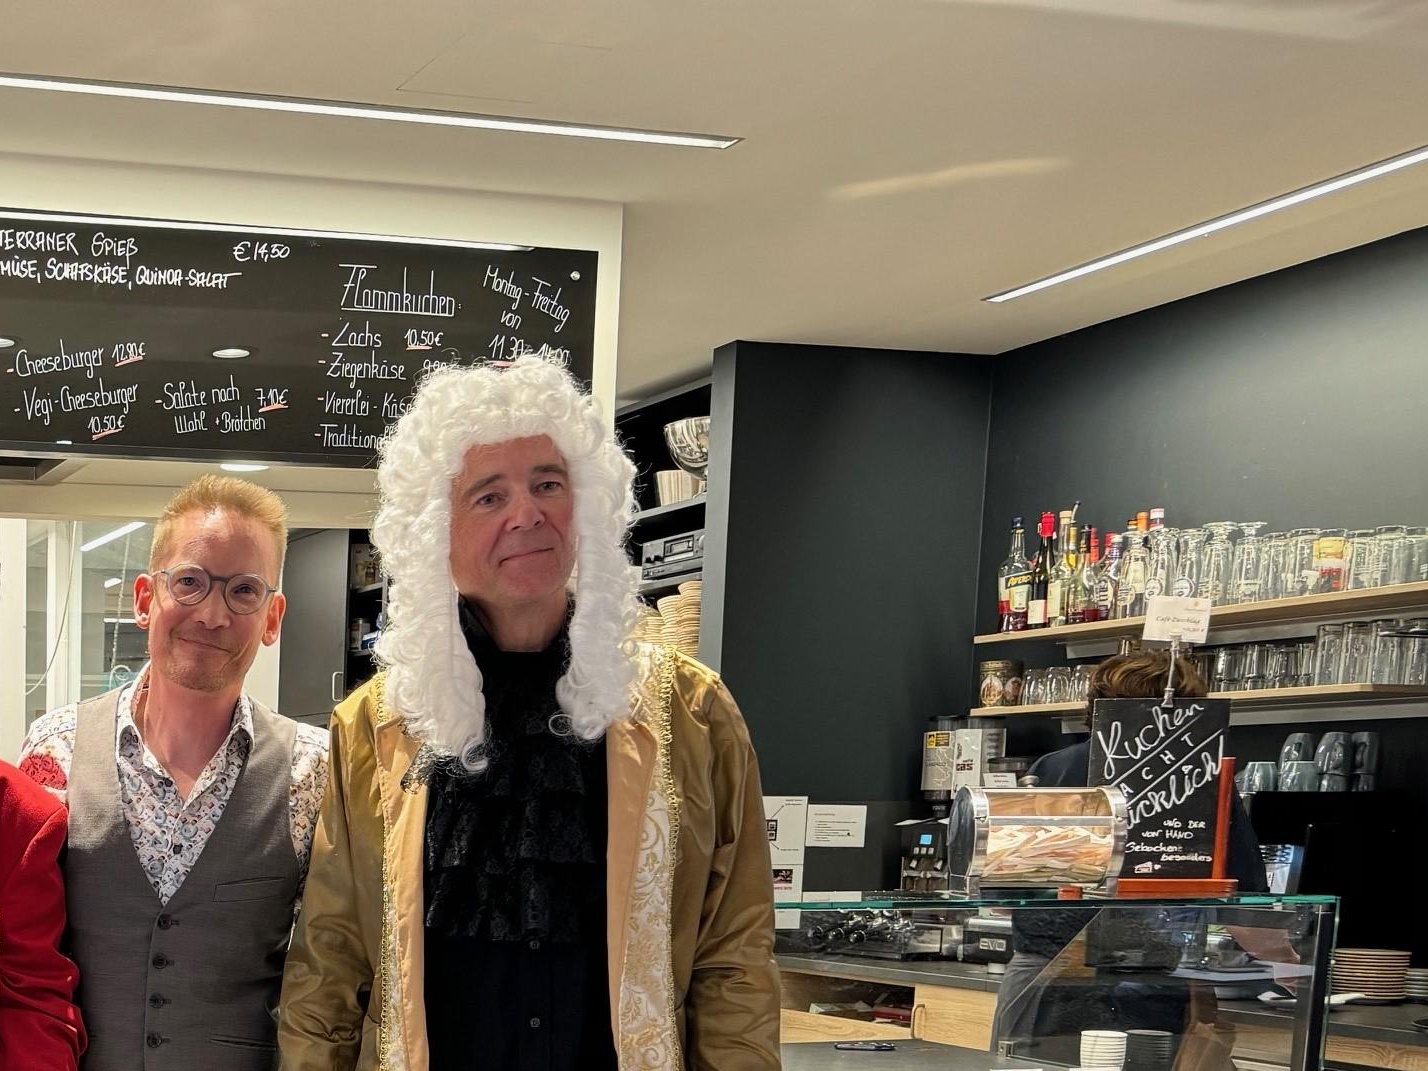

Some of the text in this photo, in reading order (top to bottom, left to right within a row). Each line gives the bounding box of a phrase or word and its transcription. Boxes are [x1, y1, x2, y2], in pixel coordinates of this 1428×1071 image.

[44, 258, 132, 290] SCHAFSKÄSE,
[500, 310, 522, 330] von
[531, 276, 571, 332] Freitag
[331, 321, 383, 348] Lachs
[326, 350, 407, 389] Ziegenkäse
[211, 373, 241, 403] nach
[174, 410, 208, 434] Wahl
[220, 408, 267, 434] Brötchen
[1097, 703, 1204, 779] Kuchen
[1120, 732, 1194, 796] ACHT
